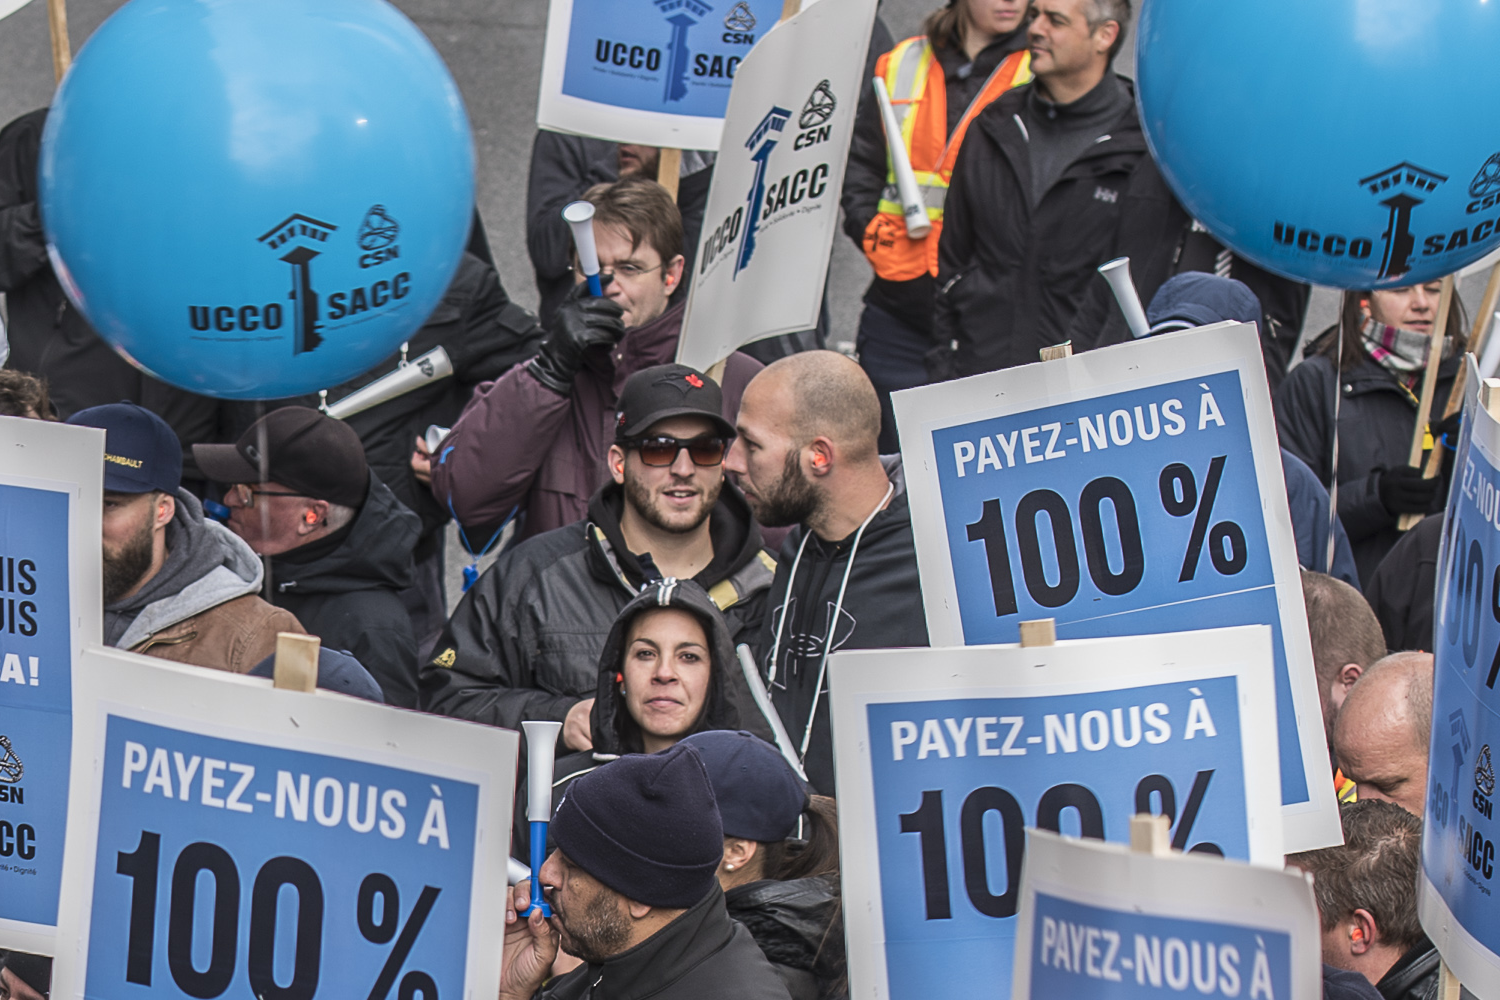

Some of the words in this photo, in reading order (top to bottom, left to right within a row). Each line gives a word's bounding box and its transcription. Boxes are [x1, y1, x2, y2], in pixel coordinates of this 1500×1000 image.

[595, 39, 661, 71] UCCO
[693, 53, 742, 79] SAC
[722, 32, 754, 45] CSN
[793, 124, 832, 151] CSN
[700, 206, 743, 275] UCCO
[762, 163, 829, 221] SACC
[1273, 219, 1372, 259] UCCO
[358, 245, 400, 268] CSN
[188, 303, 283, 332] UCCO
[327, 271, 411, 320] SACC
[953, 398, 1186, 477] PAYEZ-NOUS
[1198, 383, 1225, 431] À
[966, 476, 1145, 617] 100
[1158, 455, 1247, 583] %
[890, 702, 1172, 761] PAYEZ-NOUS
[1184, 687, 1217, 739] À
[122, 740, 407, 840] PAYEZ-NOUS
[418, 784, 450, 850] À
[1473, 789, 1493, 820] CSN
[1458, 815, 1494, 879] SACC
[1041, 917, 1241, 999] PAYEZ-NOUS
